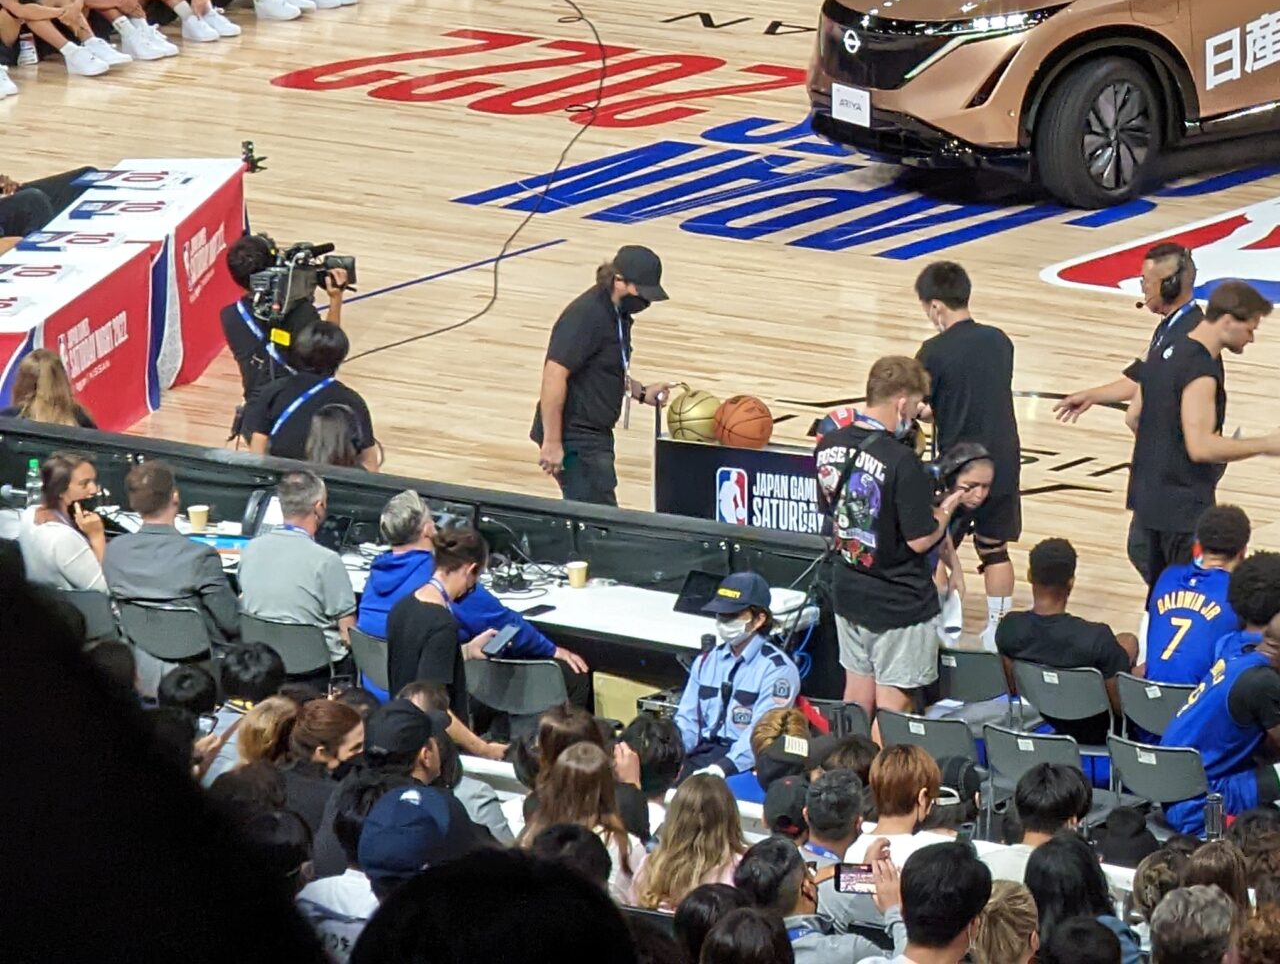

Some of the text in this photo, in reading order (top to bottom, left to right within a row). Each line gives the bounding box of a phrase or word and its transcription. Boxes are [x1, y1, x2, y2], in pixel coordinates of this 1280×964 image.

[753, 473, 818, 503] JAPAN GAM
[1160, 616, 1193, 660] 7
